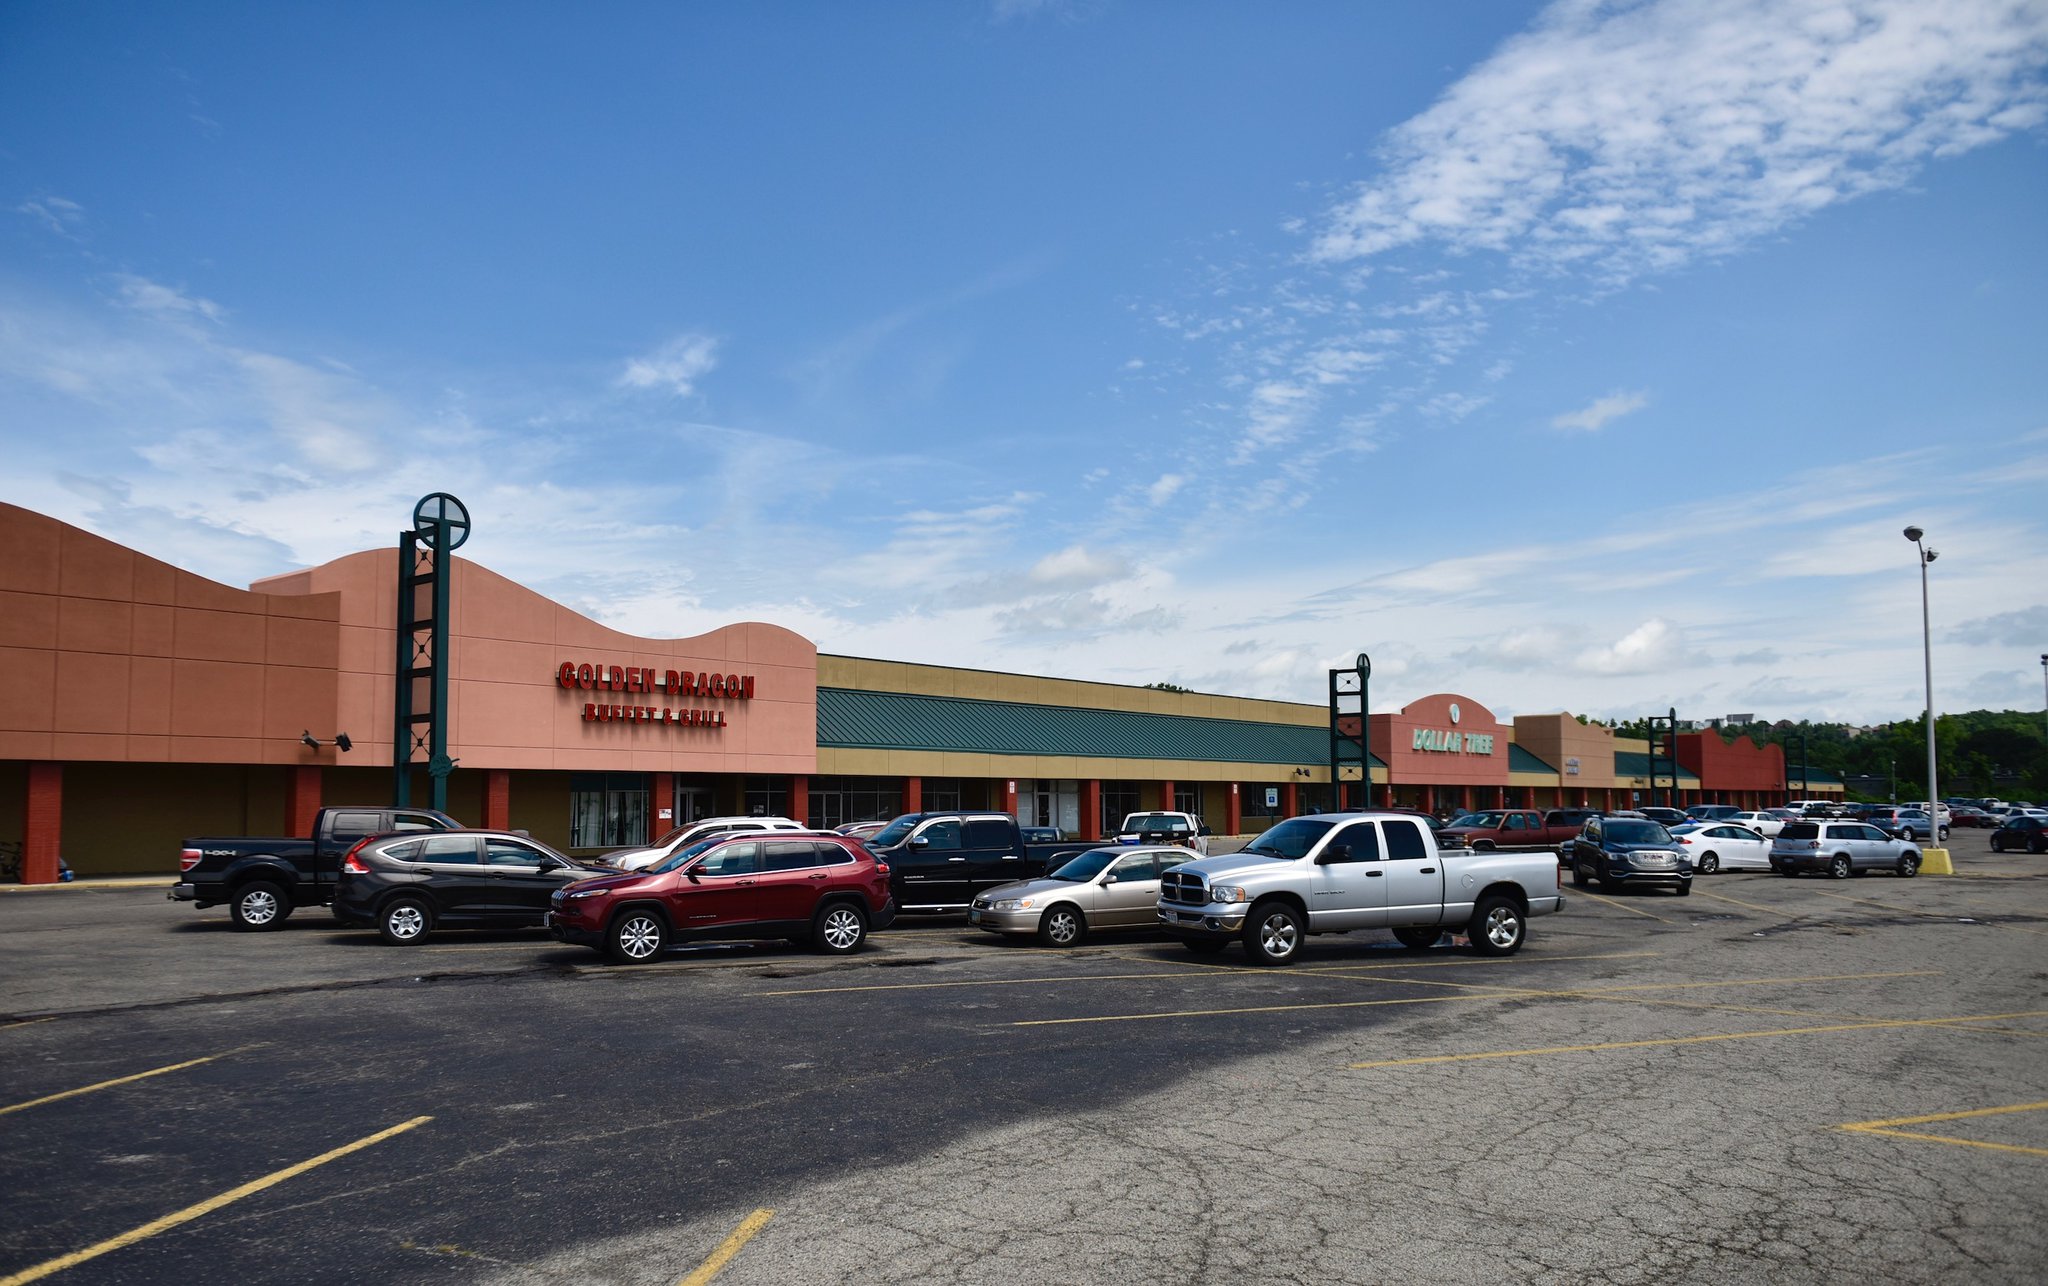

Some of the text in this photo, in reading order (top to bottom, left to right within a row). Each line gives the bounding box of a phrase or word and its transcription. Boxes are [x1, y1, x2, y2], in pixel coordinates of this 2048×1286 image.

[559, 661, 755, 699] GOLDEN DRAGON
[584, 703, 728, 727] BUFFET & GRILL
[1413, 728, 1494, 755] DOLLAR TREE
